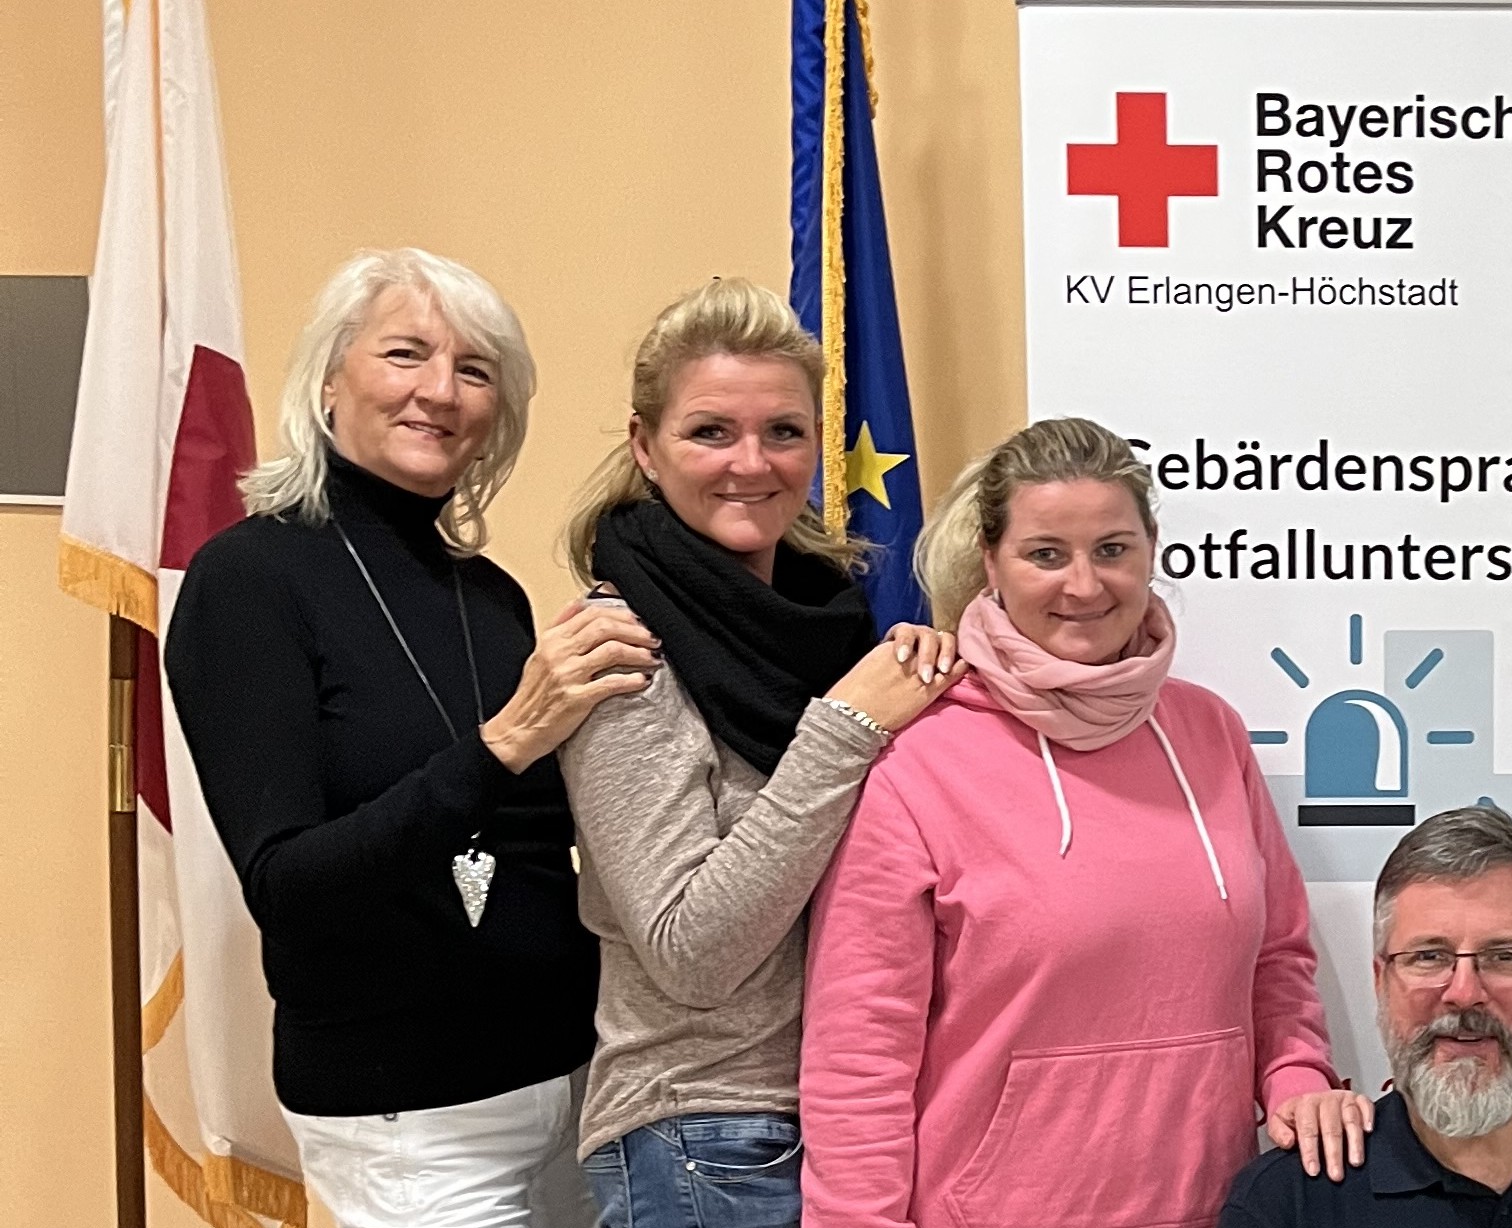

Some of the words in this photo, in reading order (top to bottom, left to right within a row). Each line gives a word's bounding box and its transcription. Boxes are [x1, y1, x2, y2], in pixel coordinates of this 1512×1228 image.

[1256, 149, 1414, 195] Rotes
[1256, 204, 1414, 250] Kreuz
[1065, 275, 1115, 304] KV
[1127, 274, 1459, 313] Erlangen-Höchstadt
